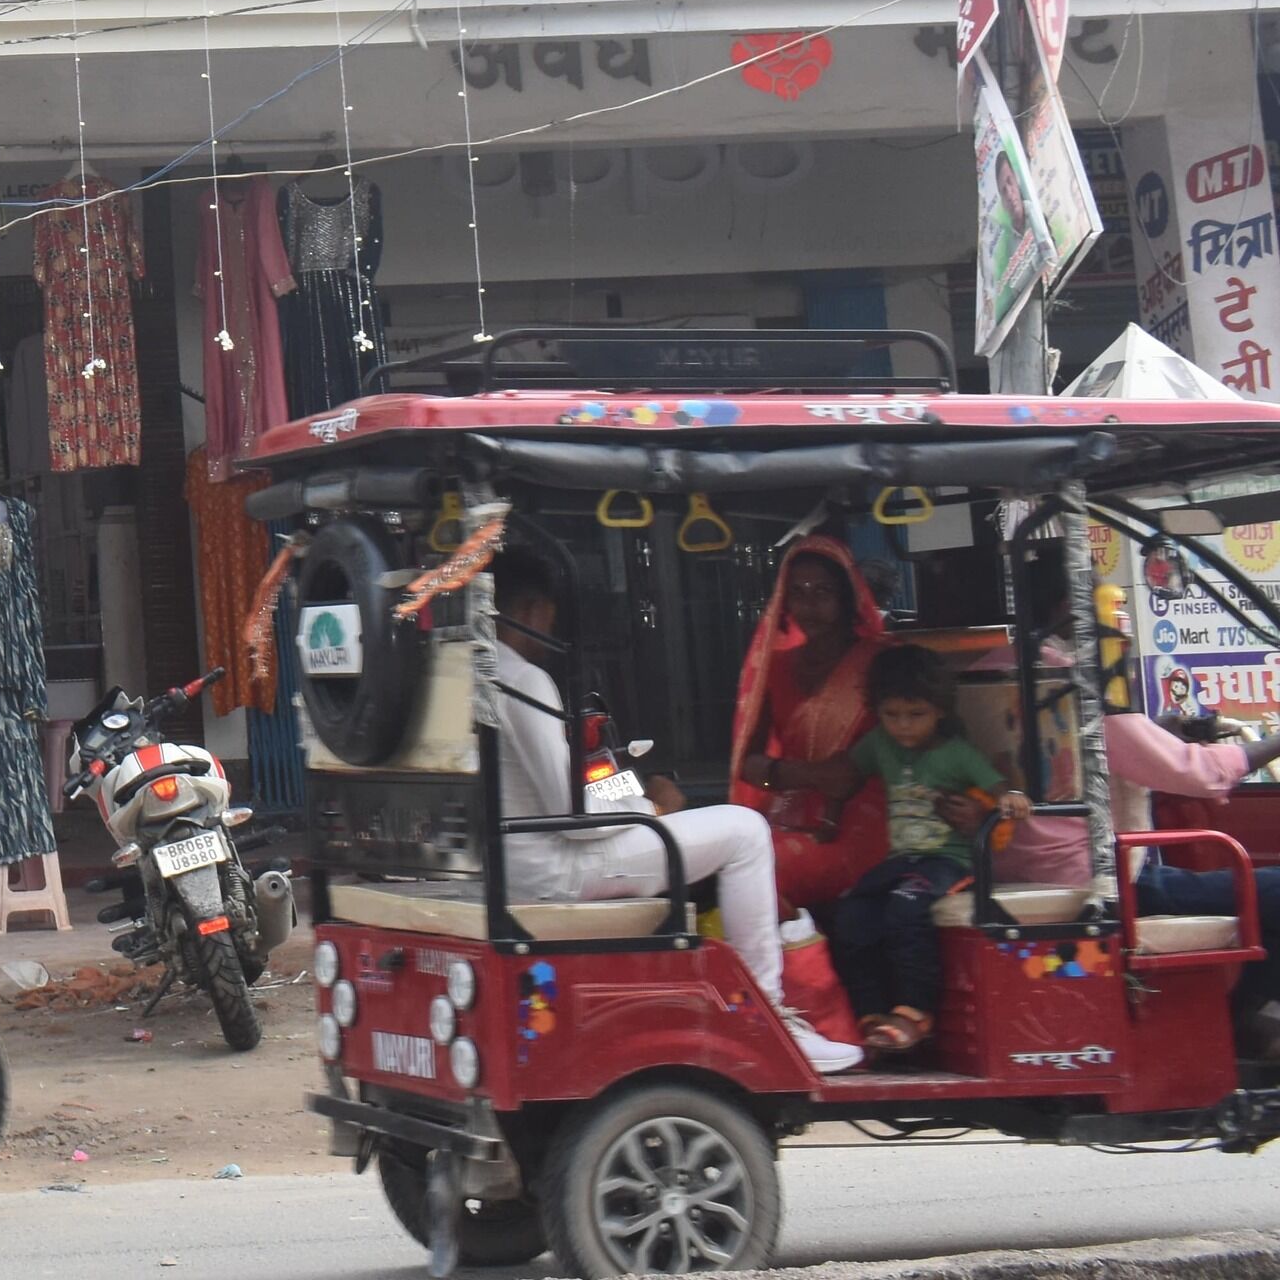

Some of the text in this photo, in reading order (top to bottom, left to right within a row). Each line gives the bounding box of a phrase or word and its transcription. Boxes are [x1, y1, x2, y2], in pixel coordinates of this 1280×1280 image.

[1186, 212, 1273, 274] मित्रा
[802, 399, 930, 425] मयूरी
[308, 408, 361, 443] मयूरी
[1243, 543, 1266, 561] पर
[1155, 627, 1210, 645] Jio Mart
[1007, 1045, 1116, 1070] मयूरी
